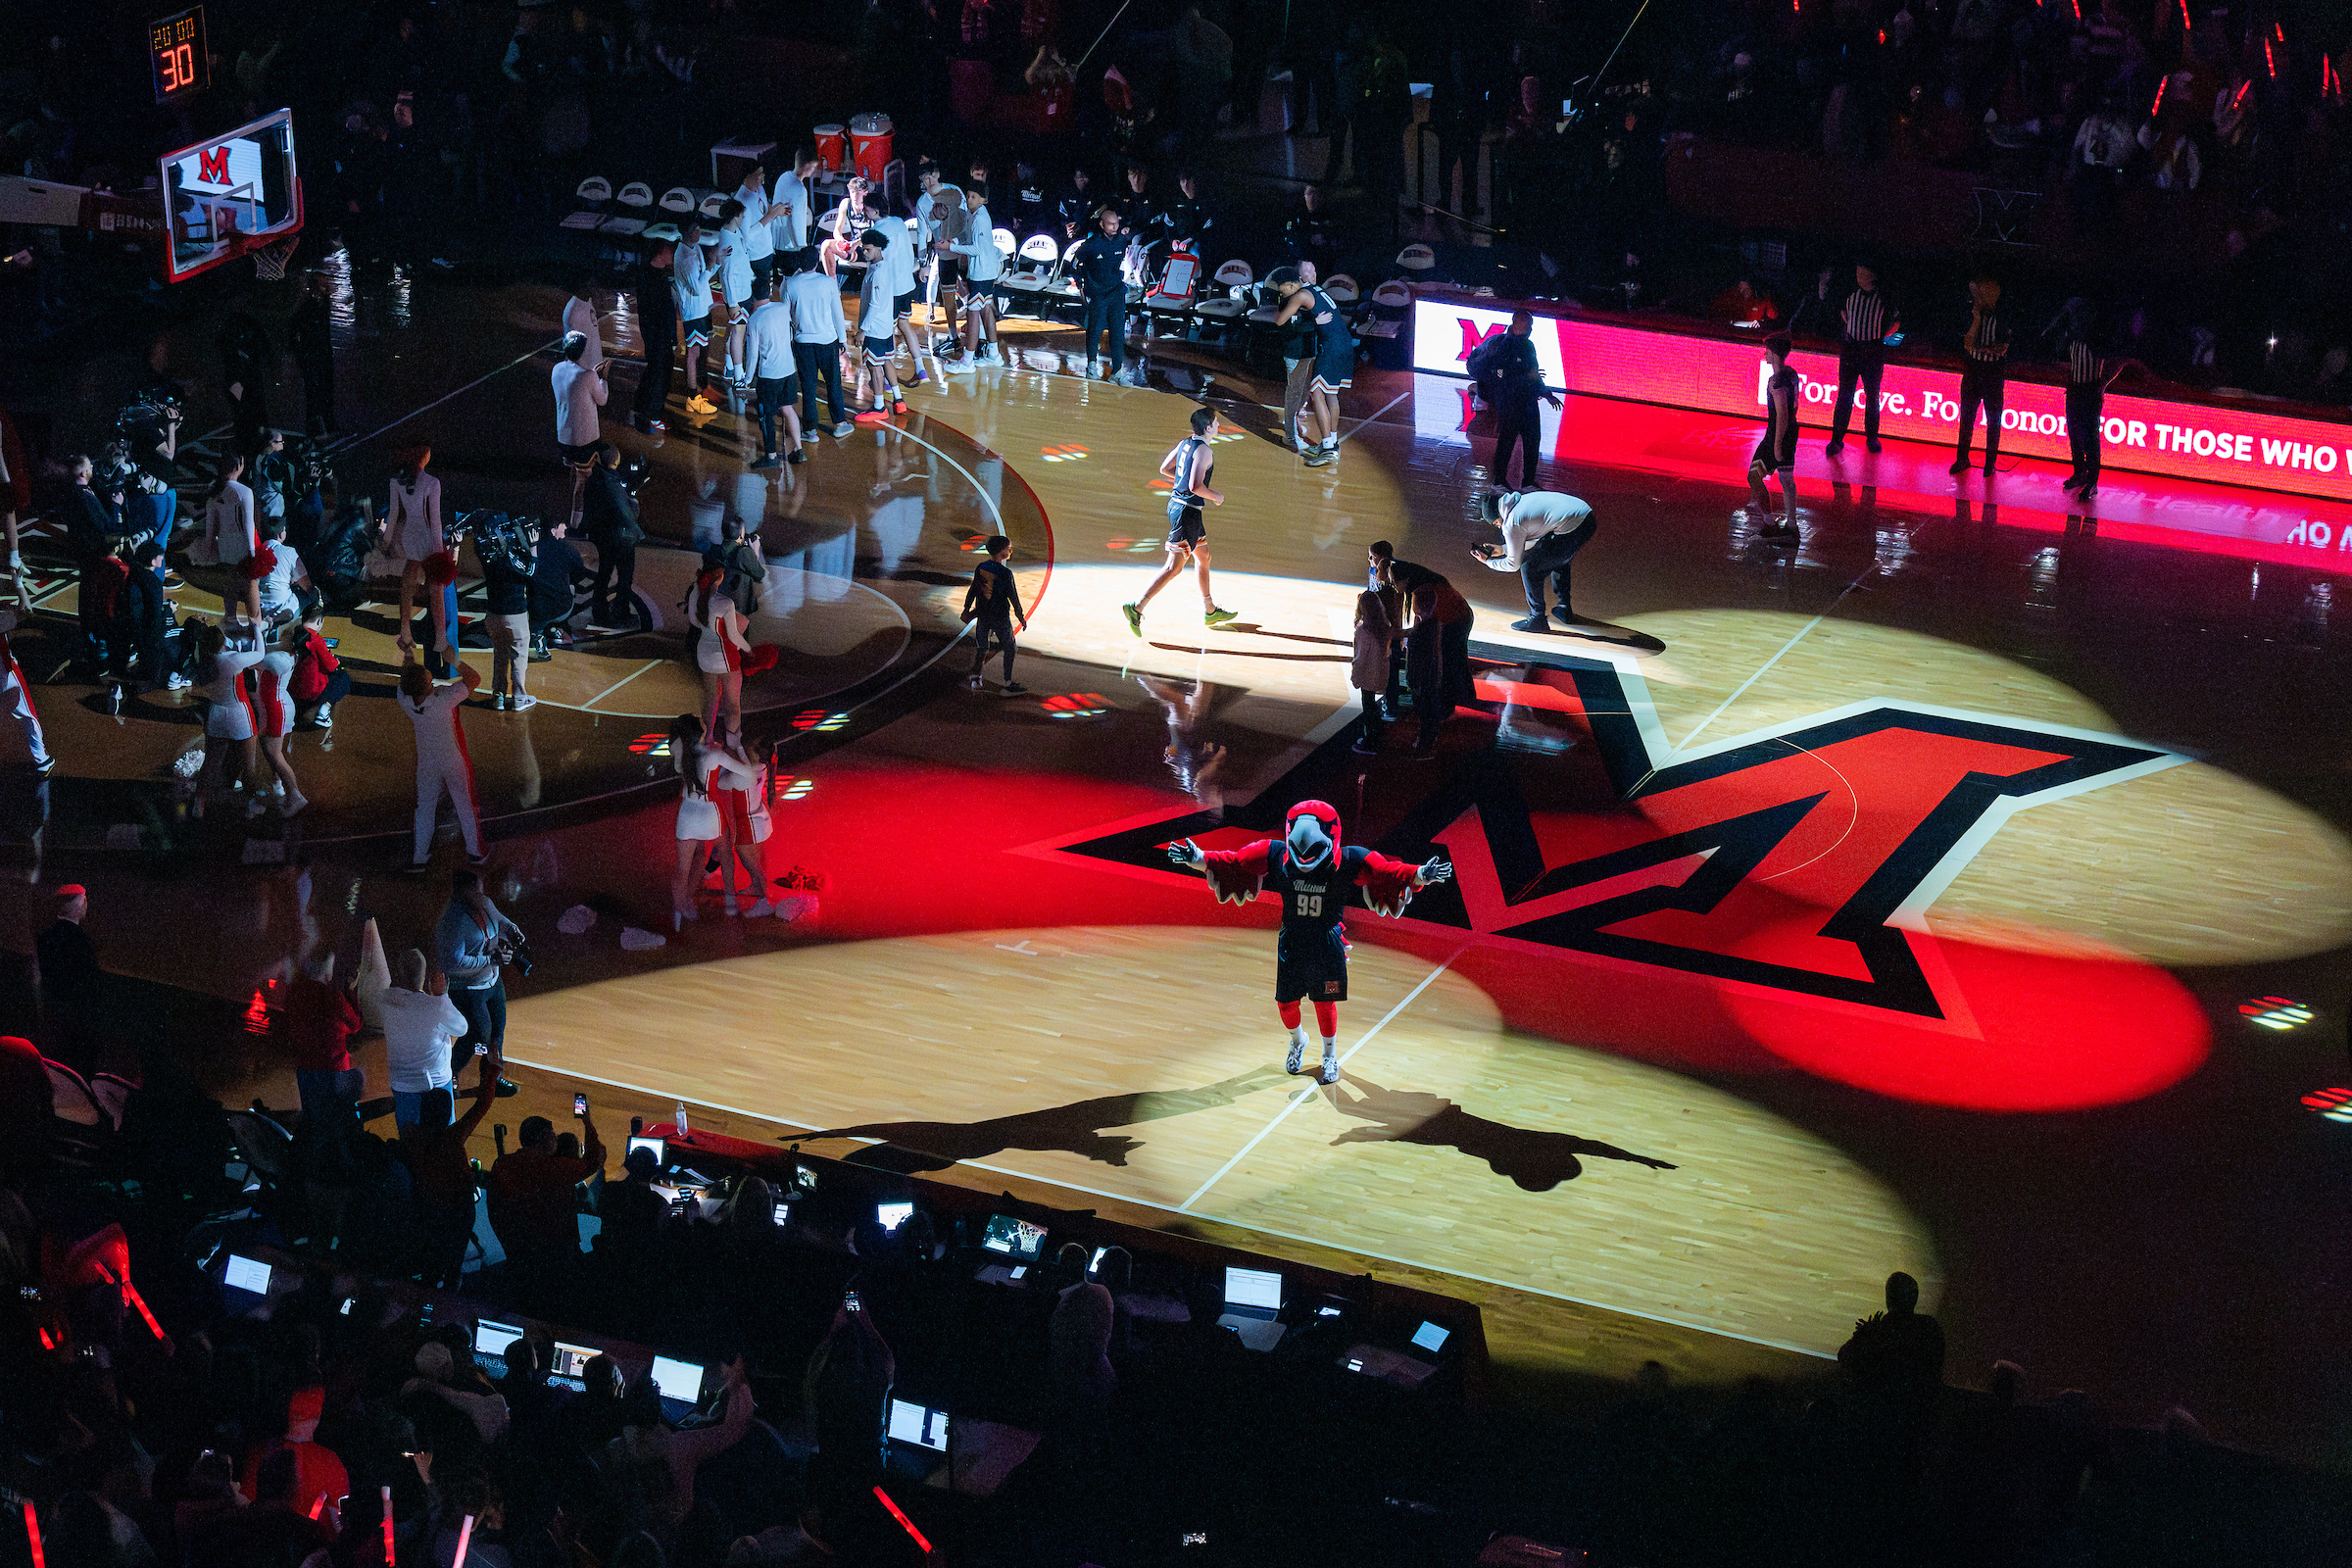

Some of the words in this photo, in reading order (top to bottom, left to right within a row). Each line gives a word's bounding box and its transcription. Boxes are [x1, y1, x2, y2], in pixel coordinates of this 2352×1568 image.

[161, 43, 195, 92] 30
[198, 145, 234, 186] M
[1852, 388, 1912, 416] ove.
[1921, 390, 1961, 422] Fo
[2099, 416, 2147, 447] OR
[2154, 423, 2254, 462] THOSE
[2260, 437, 2338, 472] WHO
[1297, 894, 1323, 917] 99
